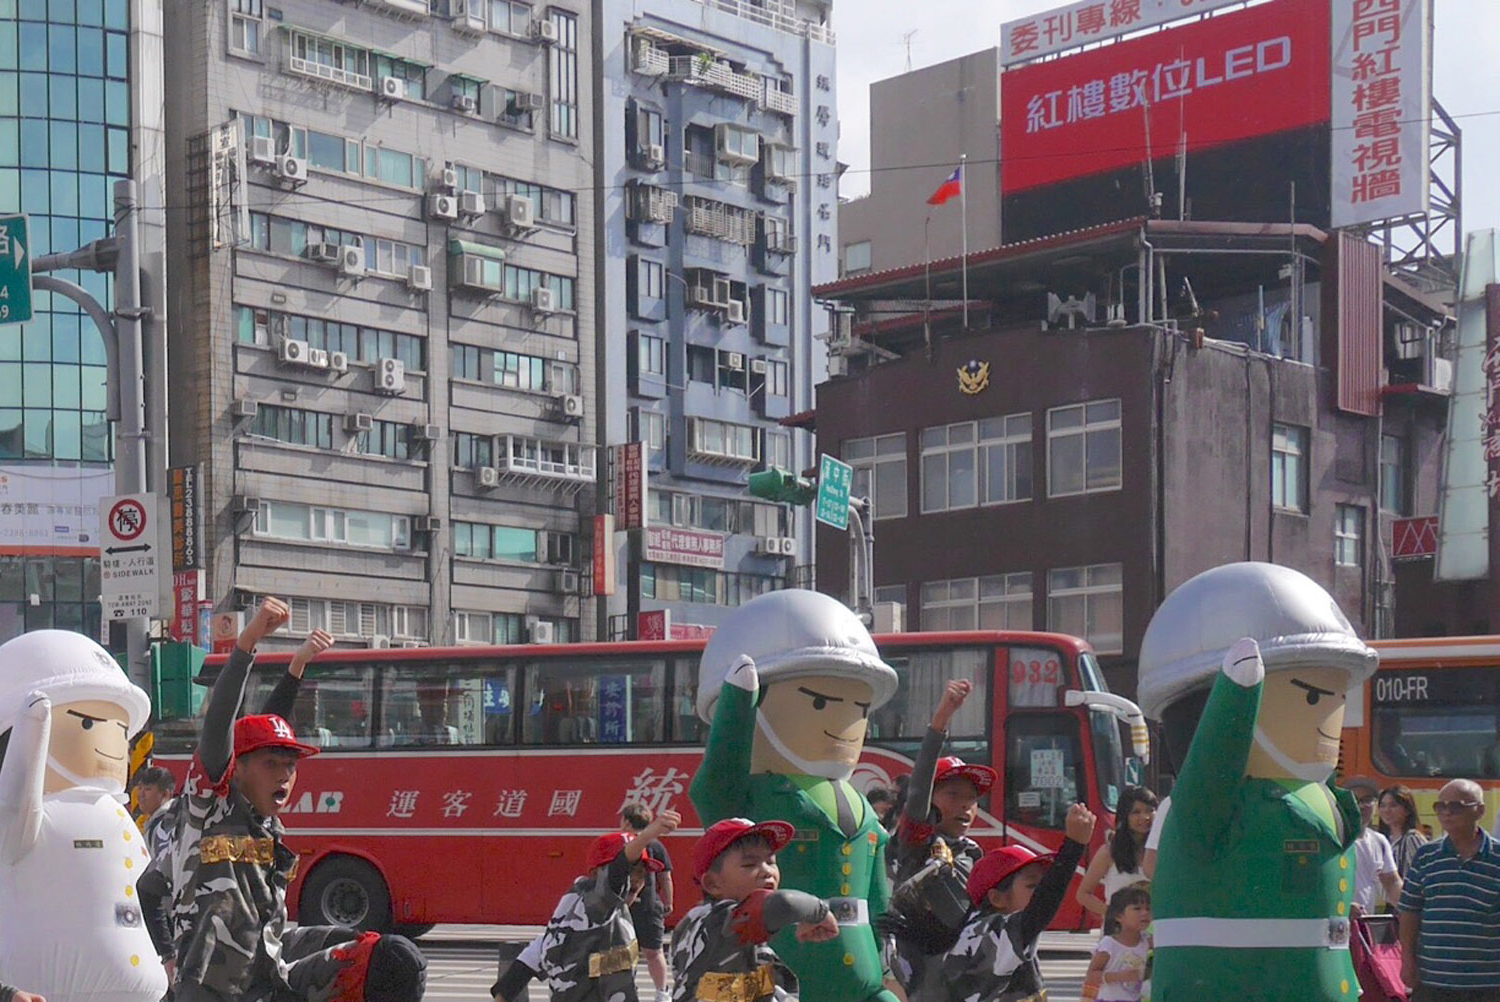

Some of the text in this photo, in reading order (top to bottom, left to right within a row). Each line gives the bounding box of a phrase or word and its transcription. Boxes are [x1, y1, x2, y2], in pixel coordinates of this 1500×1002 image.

[1027, 36, 1291, 134] 紅樓數位LED
[1352, 0, 1402, 204] 西門紅樓電視牆
[112, 569, 155, 579] SIDEWALK
[130, 607, 147, 616] 110
[1012, 659, 1059, 685] 932
[1376, 676, 1429, 701] 010-FR
[268, 717, 293, 740] LA
